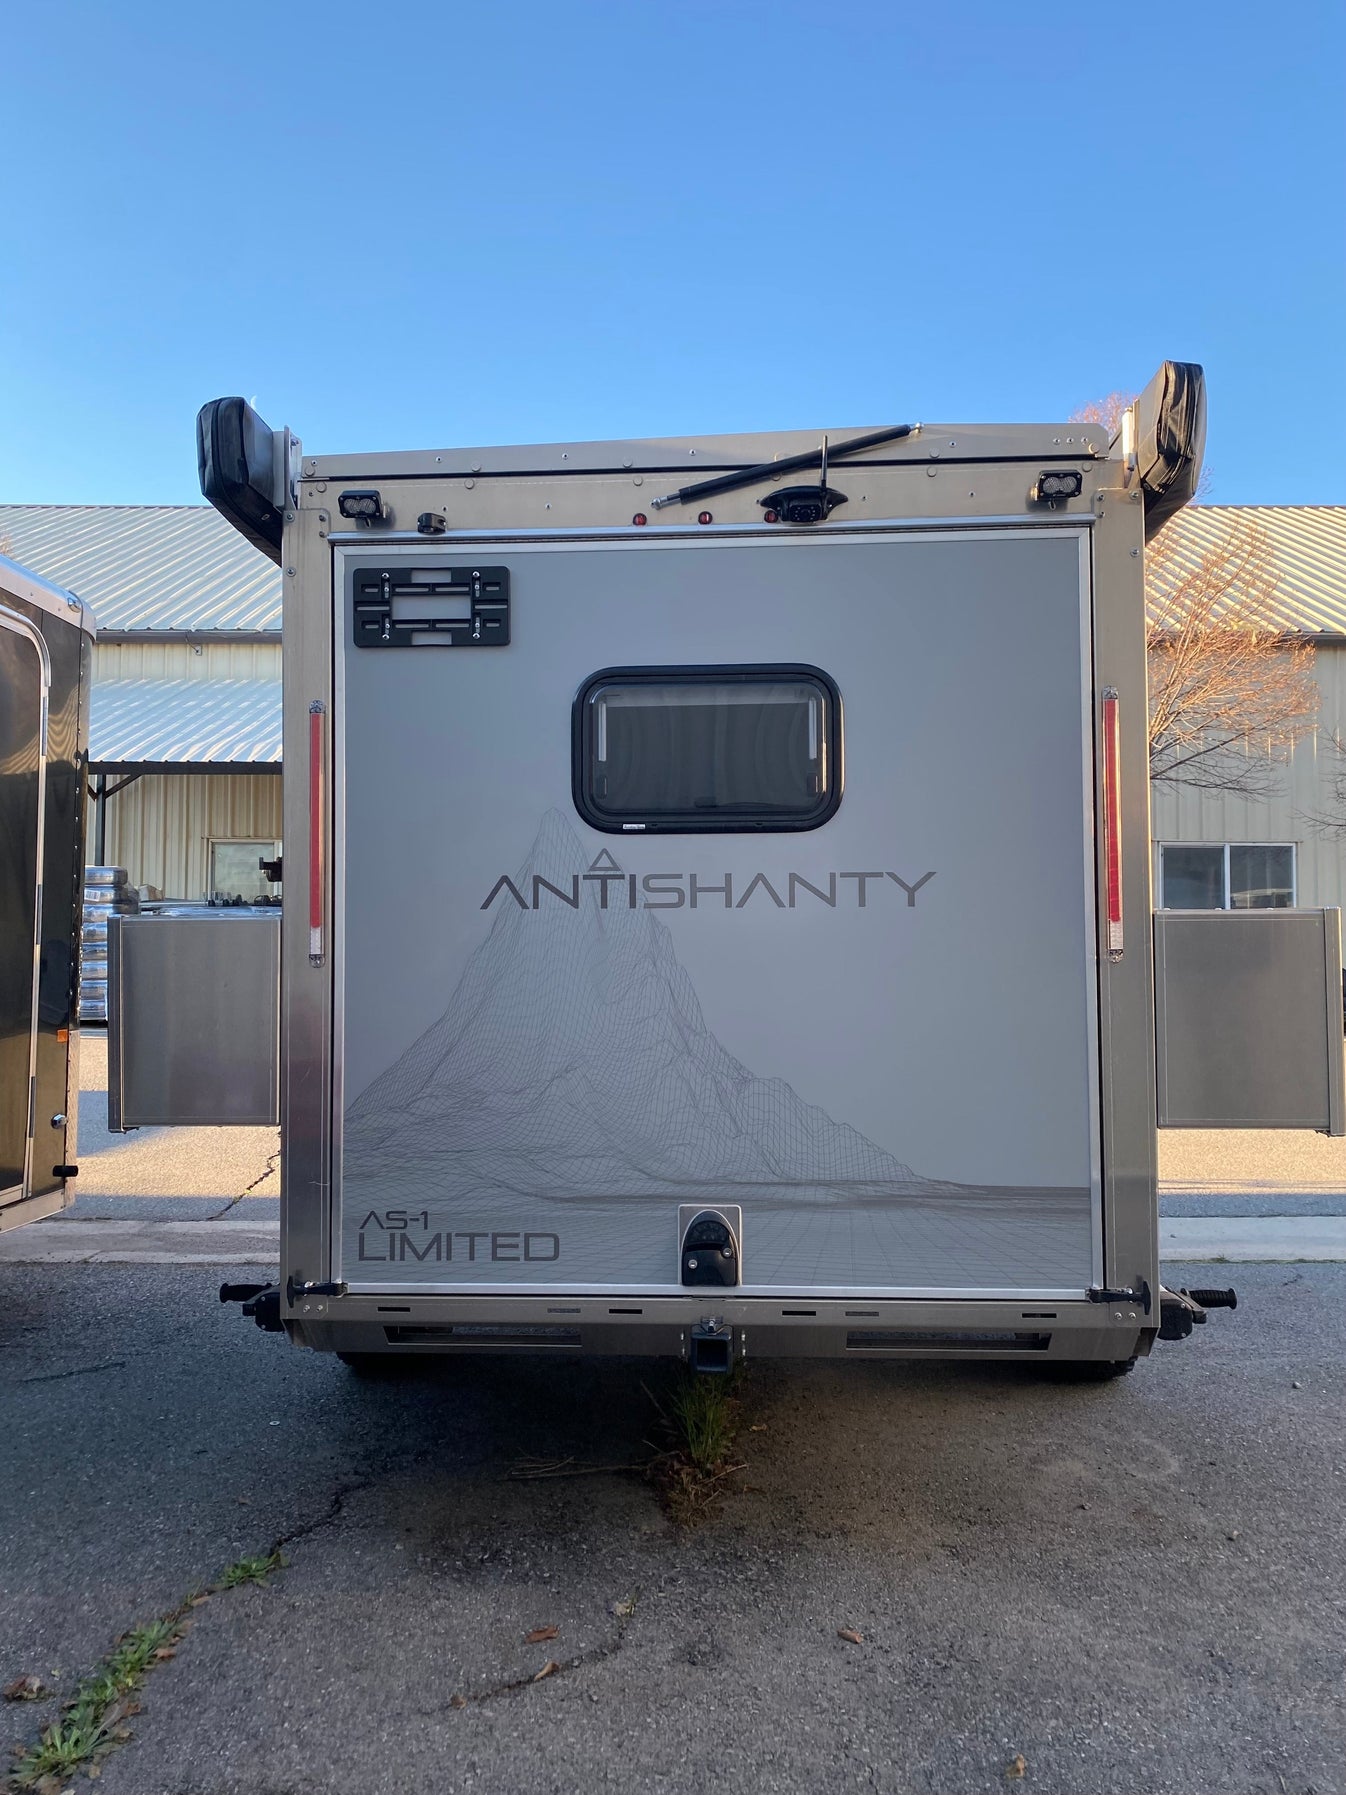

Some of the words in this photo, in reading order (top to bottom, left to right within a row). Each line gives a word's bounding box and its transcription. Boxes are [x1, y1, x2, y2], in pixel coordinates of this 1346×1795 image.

[479, 871, 937, 910] ANTISHANTY
[359, 1210, 429, 1231] AS-1
[358, 1232, 560, 1262] LIMITED
